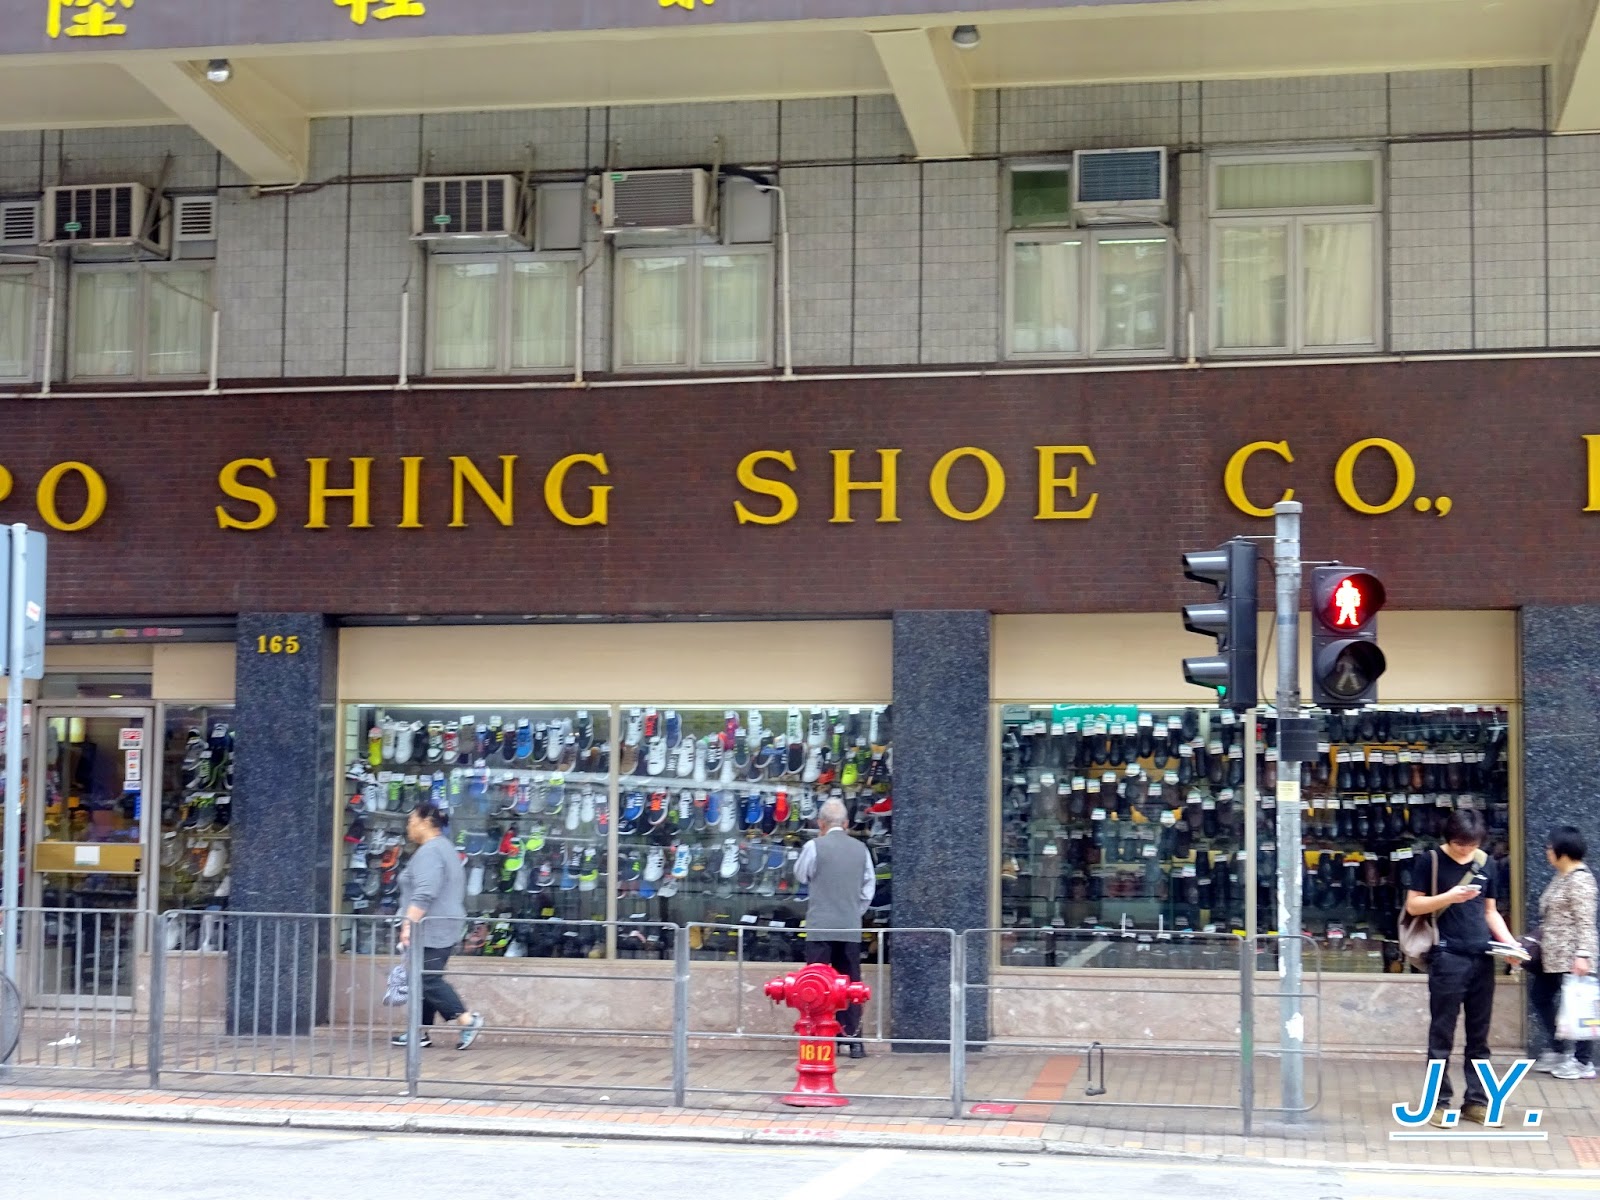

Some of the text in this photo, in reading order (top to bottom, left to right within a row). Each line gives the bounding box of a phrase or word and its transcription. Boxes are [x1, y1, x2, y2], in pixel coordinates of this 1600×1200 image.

[0, 460, 108, 532] O
[215, 451, 614, 530] SHING
[733, 445, 1099, 525] SHOE
[257, 634, 300, 654] 165
